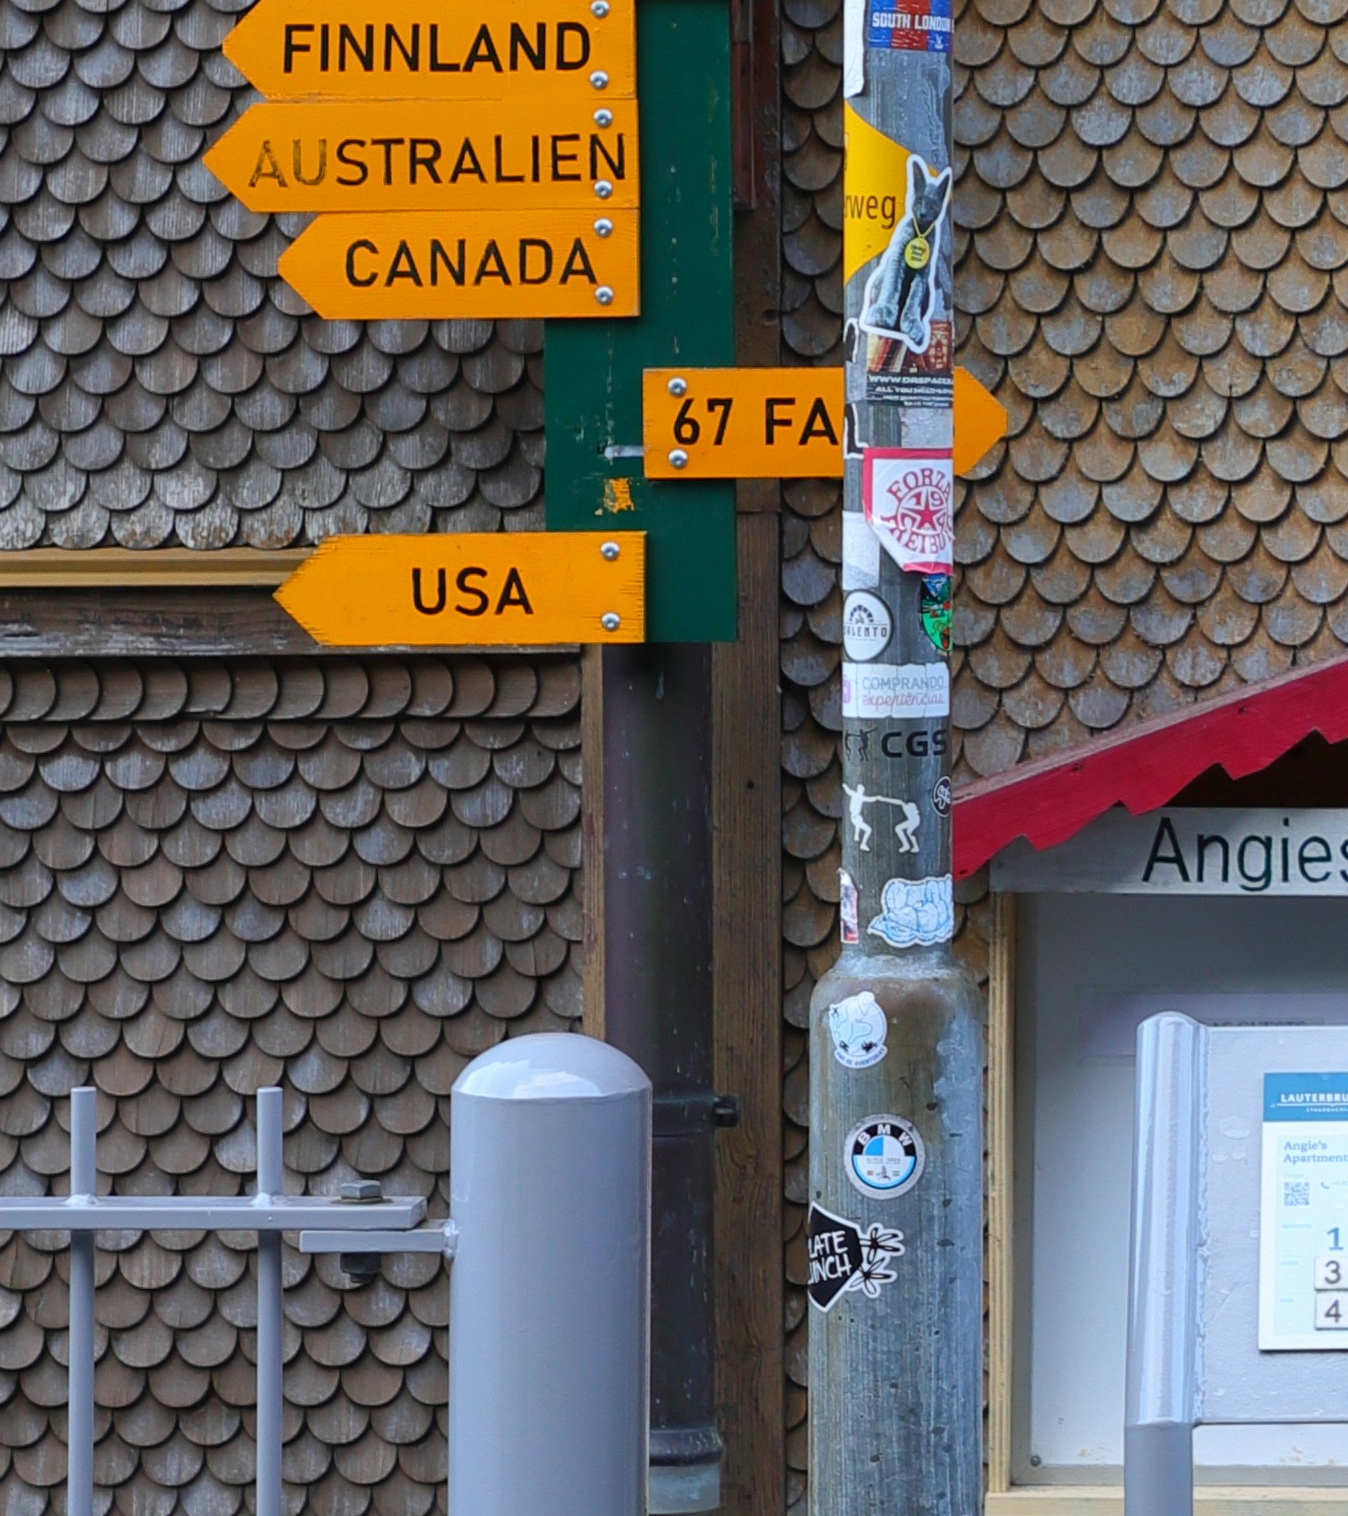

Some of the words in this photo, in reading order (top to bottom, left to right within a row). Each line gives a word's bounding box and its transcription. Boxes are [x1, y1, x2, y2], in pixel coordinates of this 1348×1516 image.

[872, 12, 911, 29] SOUTH
[283, 22, 592, 75] FINNLAND
[249, 134, 627, 189] AUSTRALIEN
[345, 237, 597, 289] CANADA
[673, 397, 733, 446] 67
[411, 567, 534, 617] USA
[862, 675, 944, 692] COMPRANDO
[857, 1124, 912, 1146] BMW
[1283, 1140, 1327, 1152] Angie's
[1327, 1227, 1344, 1250] 1
[1324, 1260, 1342, 1284] 3
[1324, 1299, 1342, 1323] 4
